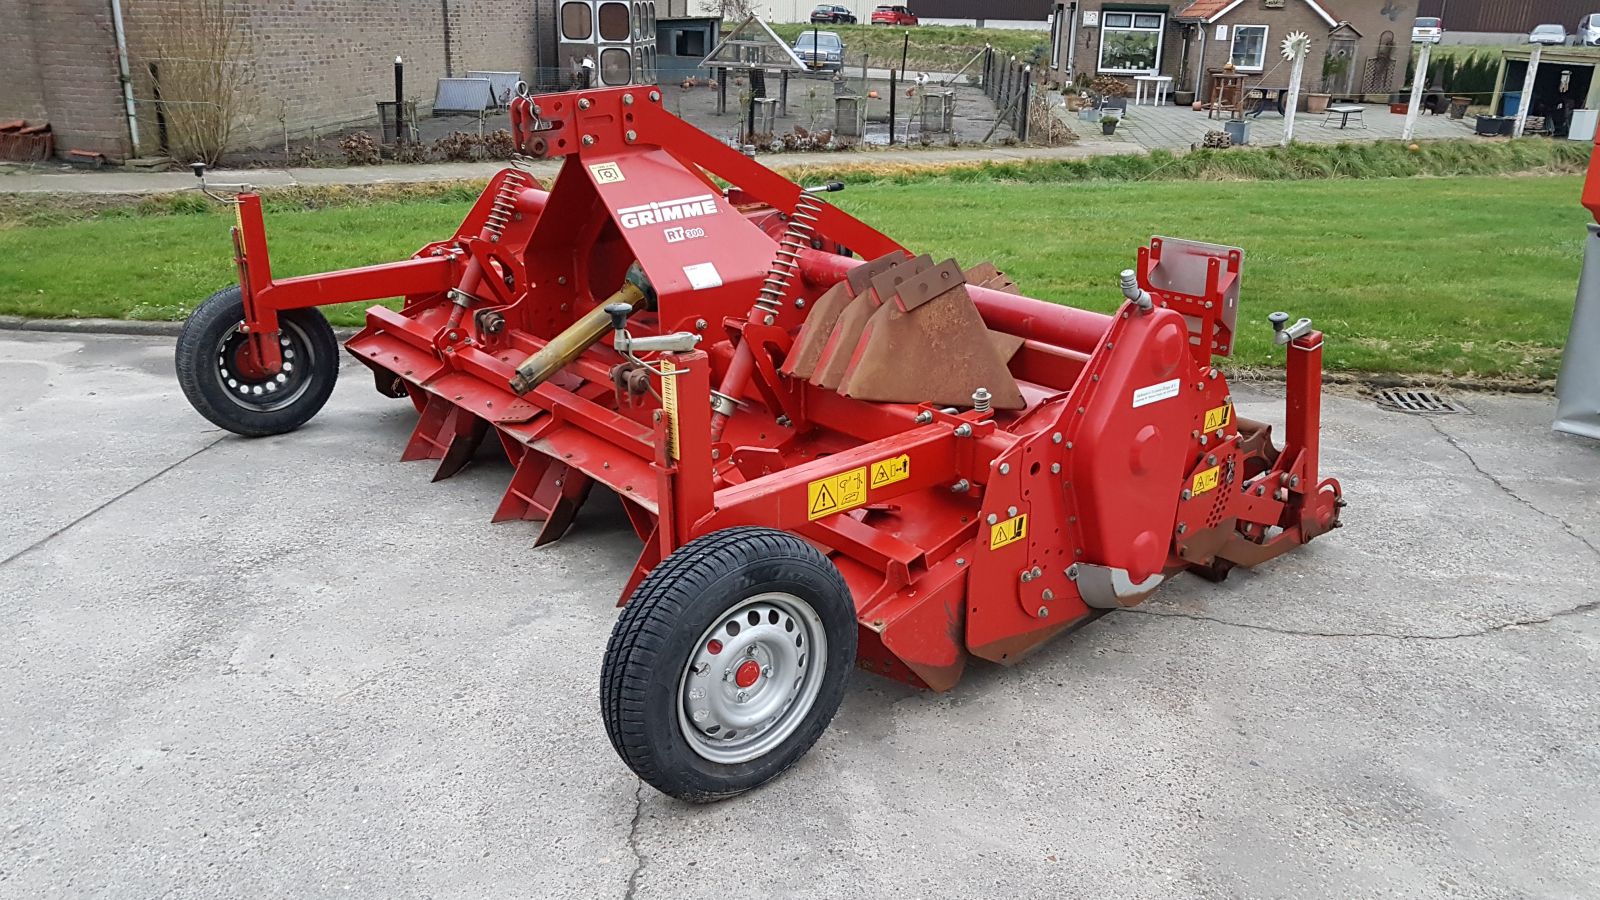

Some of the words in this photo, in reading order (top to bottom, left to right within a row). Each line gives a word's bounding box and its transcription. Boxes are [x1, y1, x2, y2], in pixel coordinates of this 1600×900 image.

[619, 199, 718, 229] GRIMME
[666, 228, 684, 241] RT
[685, 228, 704, 239] 300
